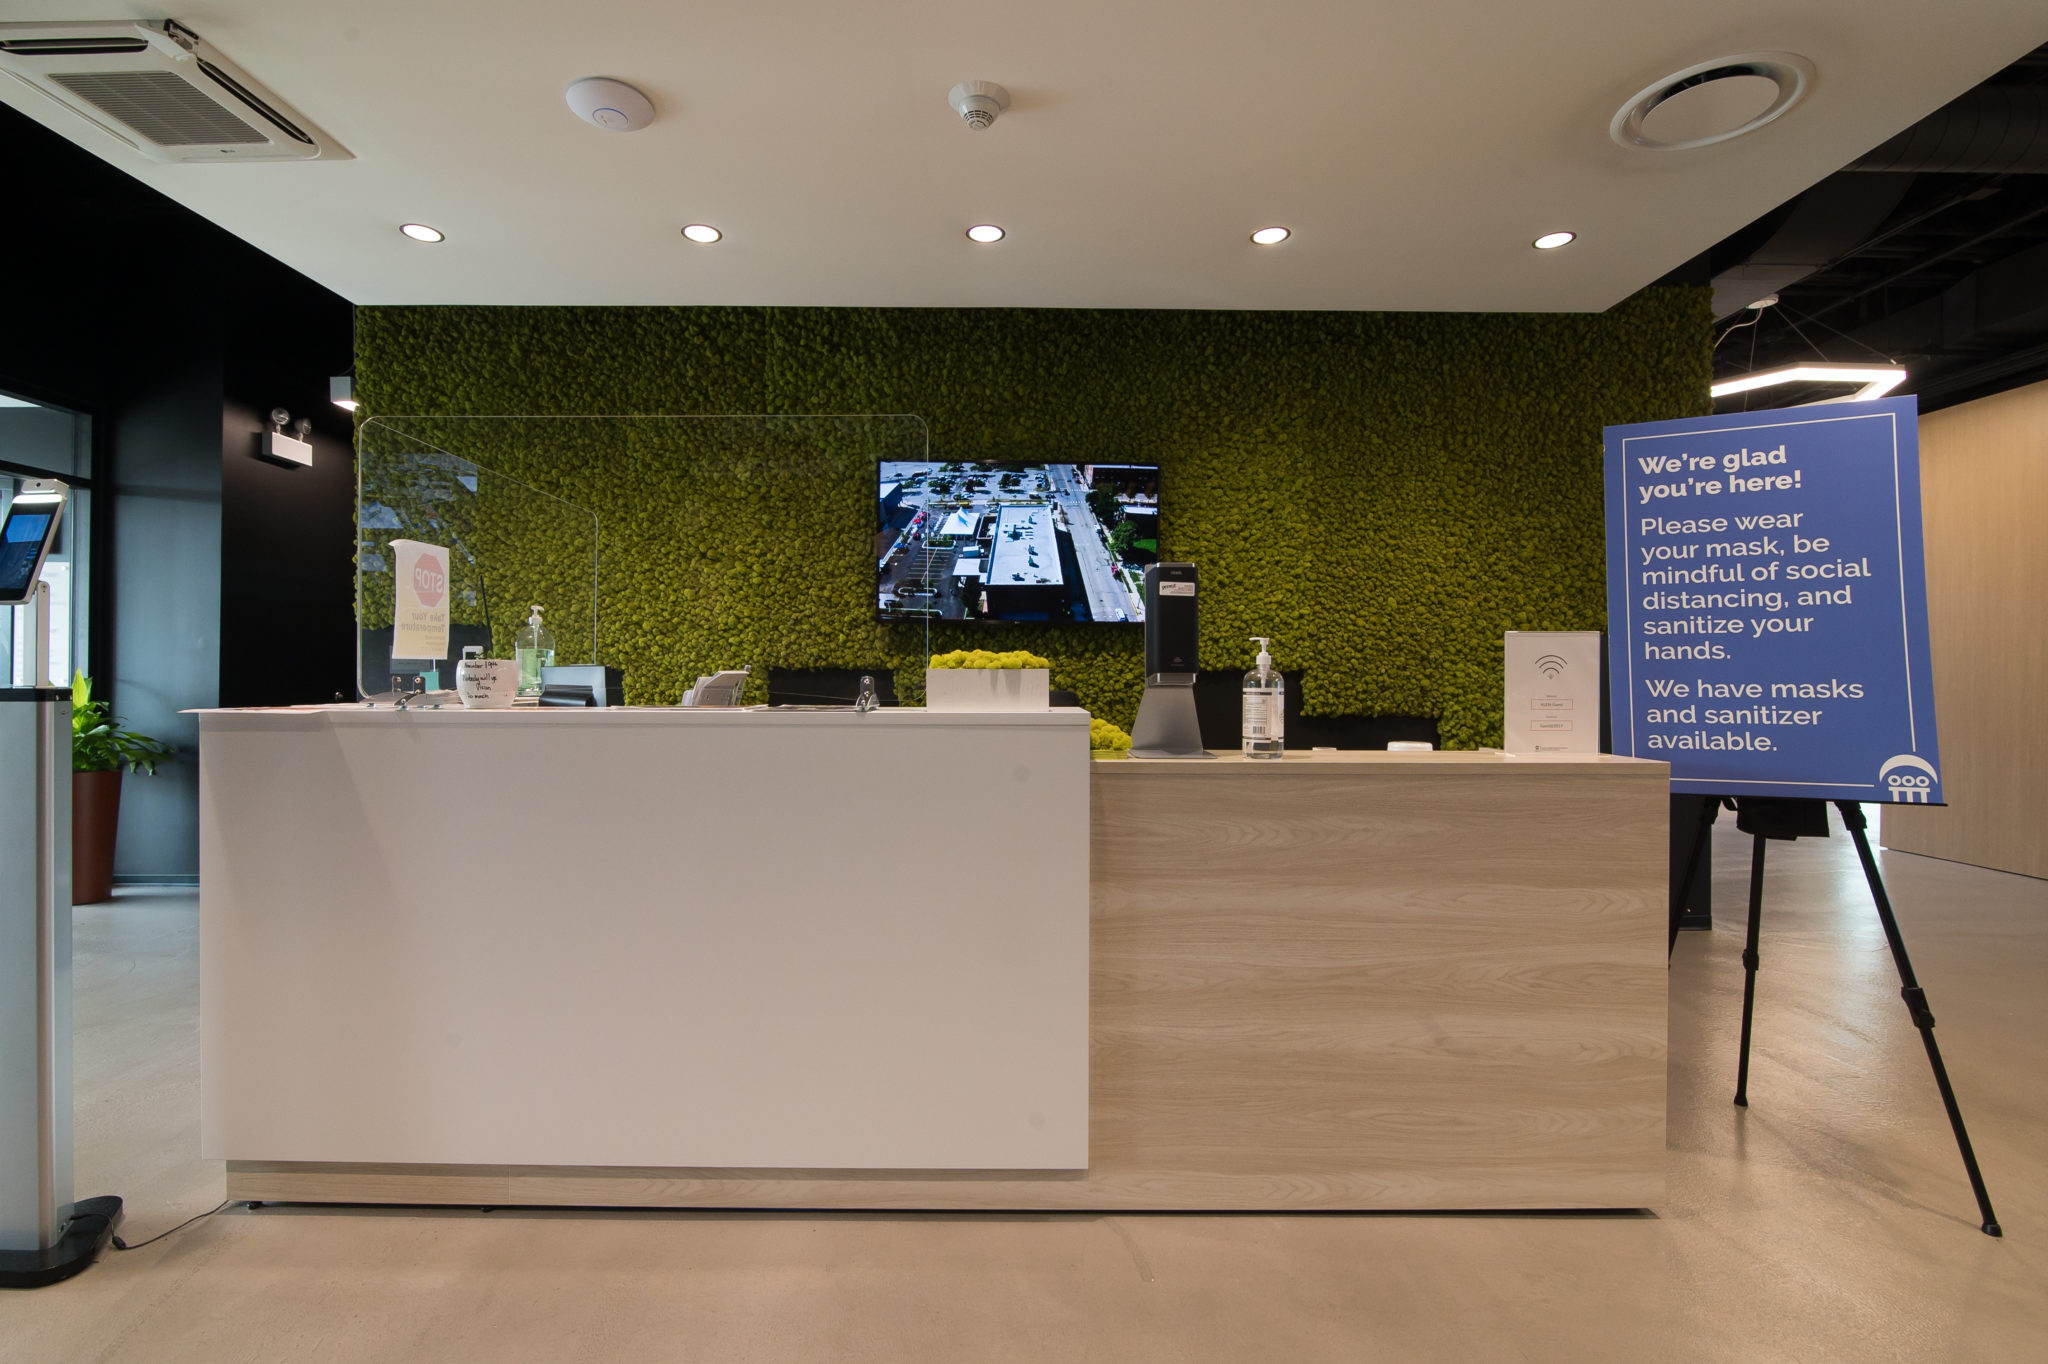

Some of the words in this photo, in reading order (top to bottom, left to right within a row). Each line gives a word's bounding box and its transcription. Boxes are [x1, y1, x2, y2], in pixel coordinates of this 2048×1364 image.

[1638, 453, 1716, 474] We're
[1723, 445, 1786, 473] glad
[1639, 478, 1722, 504] you're
[1730, 470, 1801, 493] here!
[1642, 517, 1728, 535] Please
[1735, 513, 1803, 530] wear
[1641, 545, 1699, 565] your
[1707, 536, 1784, 557] mask,
[1794, 535, 1830, 553] be
[1643, 564, 1745, 584] mindful
[1752, 562, 1779, 581] of
[1787, 558, 1871, 579] social
[1643, 589, 1788, 611] distancing,
[1798, 585, 1852, 605] and
[1644, 616, 1744, 634] sanitize
[1751, 618, 1814, 638] your
[1645, 641, 1730, 660] hands.
[1645, 680, 1689, 697] We
[1698, 679, 1762, 697] have
[1772, 679, 1864, 698] masks
[1647, 705, 1696, 723] and
[1705, 706, 1822, 725] sanitizer
[1648, 731, 1777, 751] available.
